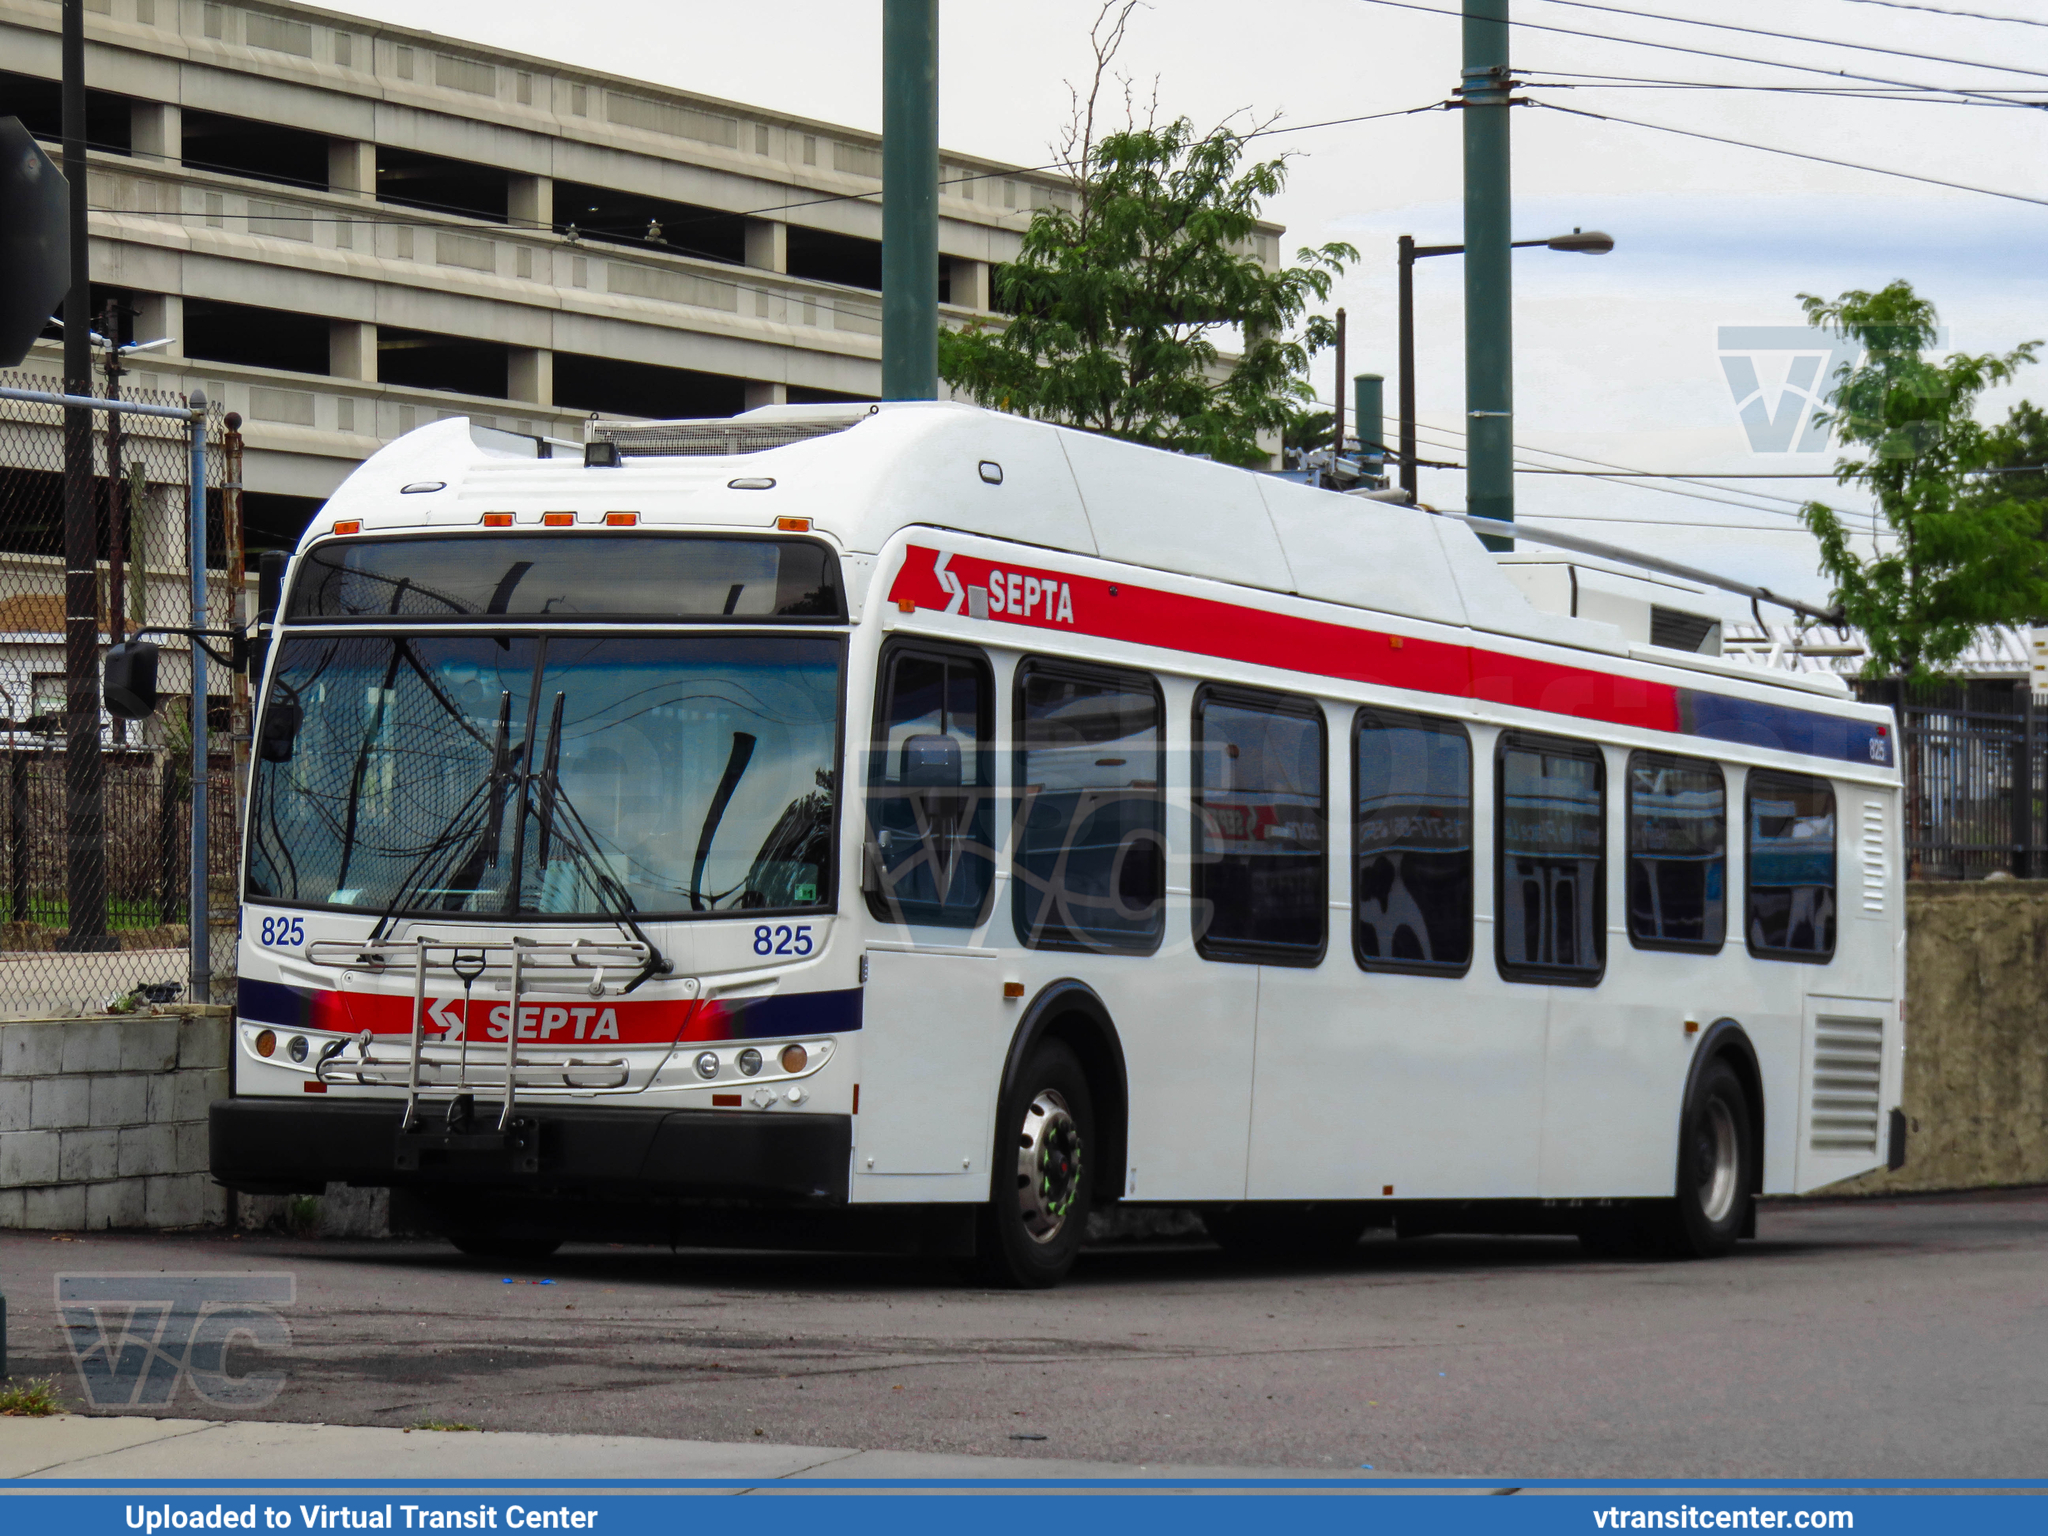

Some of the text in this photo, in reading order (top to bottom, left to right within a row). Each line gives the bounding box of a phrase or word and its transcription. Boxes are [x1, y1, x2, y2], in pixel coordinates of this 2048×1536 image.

[988, 570, 1074, 624] SEPTA
[1868, 737, 1886, 761] 825
[260, 916, 305, 946] 825
[753, 925, 813, 956] 825
[487, 1006, 619, 1040] SEPTA
